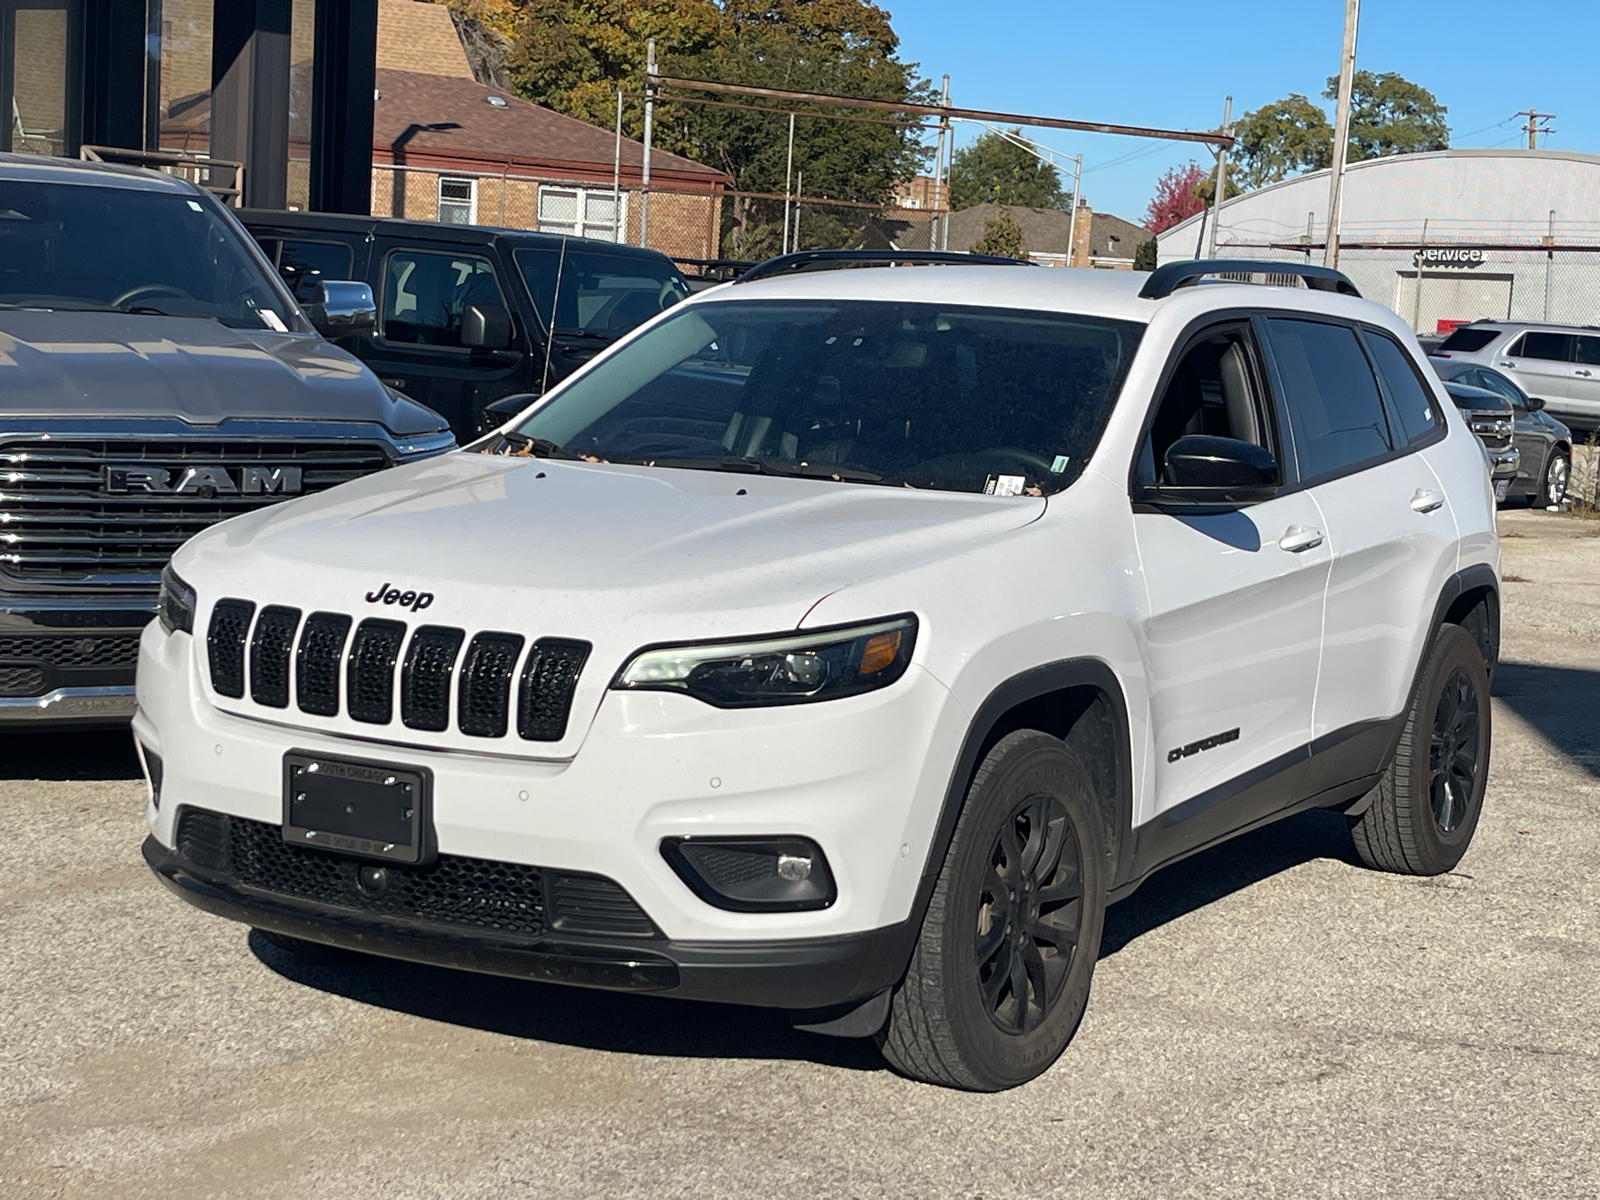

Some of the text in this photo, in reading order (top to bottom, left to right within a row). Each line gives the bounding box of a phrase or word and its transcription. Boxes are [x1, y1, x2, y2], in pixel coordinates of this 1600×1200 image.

[106, 465, 302, 493] RAM
[365, 582, 434, 612] Jeep
[347, 766, 387, 783] CHICAGO
